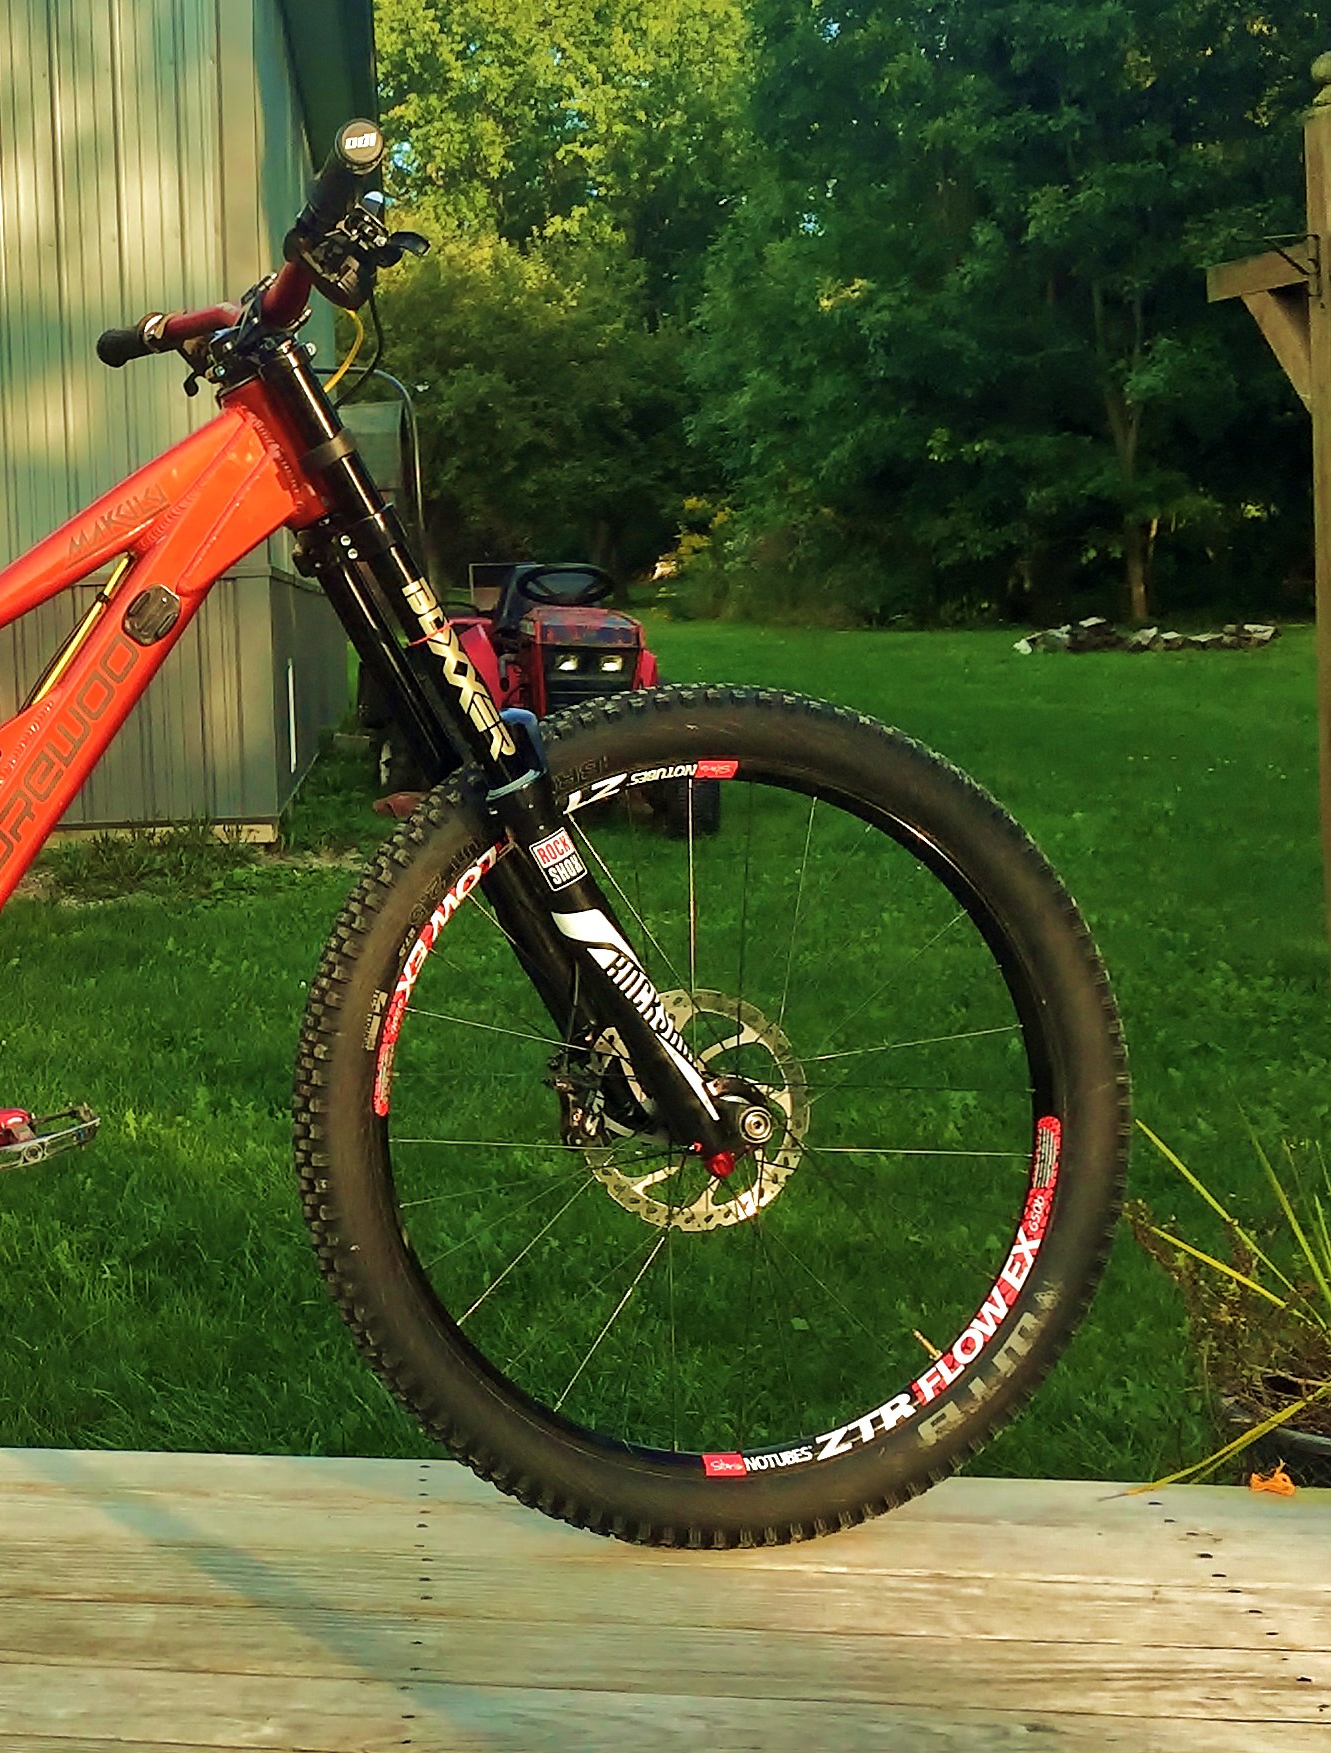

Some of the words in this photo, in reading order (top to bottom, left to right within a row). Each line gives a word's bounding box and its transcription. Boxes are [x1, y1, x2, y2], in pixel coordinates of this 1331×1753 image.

[401, 575, 517, 762] BOXXER
[562, 772, 628, 816] ZT
[629, 763, 699, 786] NOTUBES
[536, 835, 571, 865] ROCK
[547, 853, 584, 885] SHOX
[431, 842, 504, 943] LOW
[743, 1446, 815, 1472] NOTUBES
[815, 1392, 917, 1462] ZTR
[916, 1286, 1010, 1403] FLOW
[1002, 1226, 1043, 1293] EX
